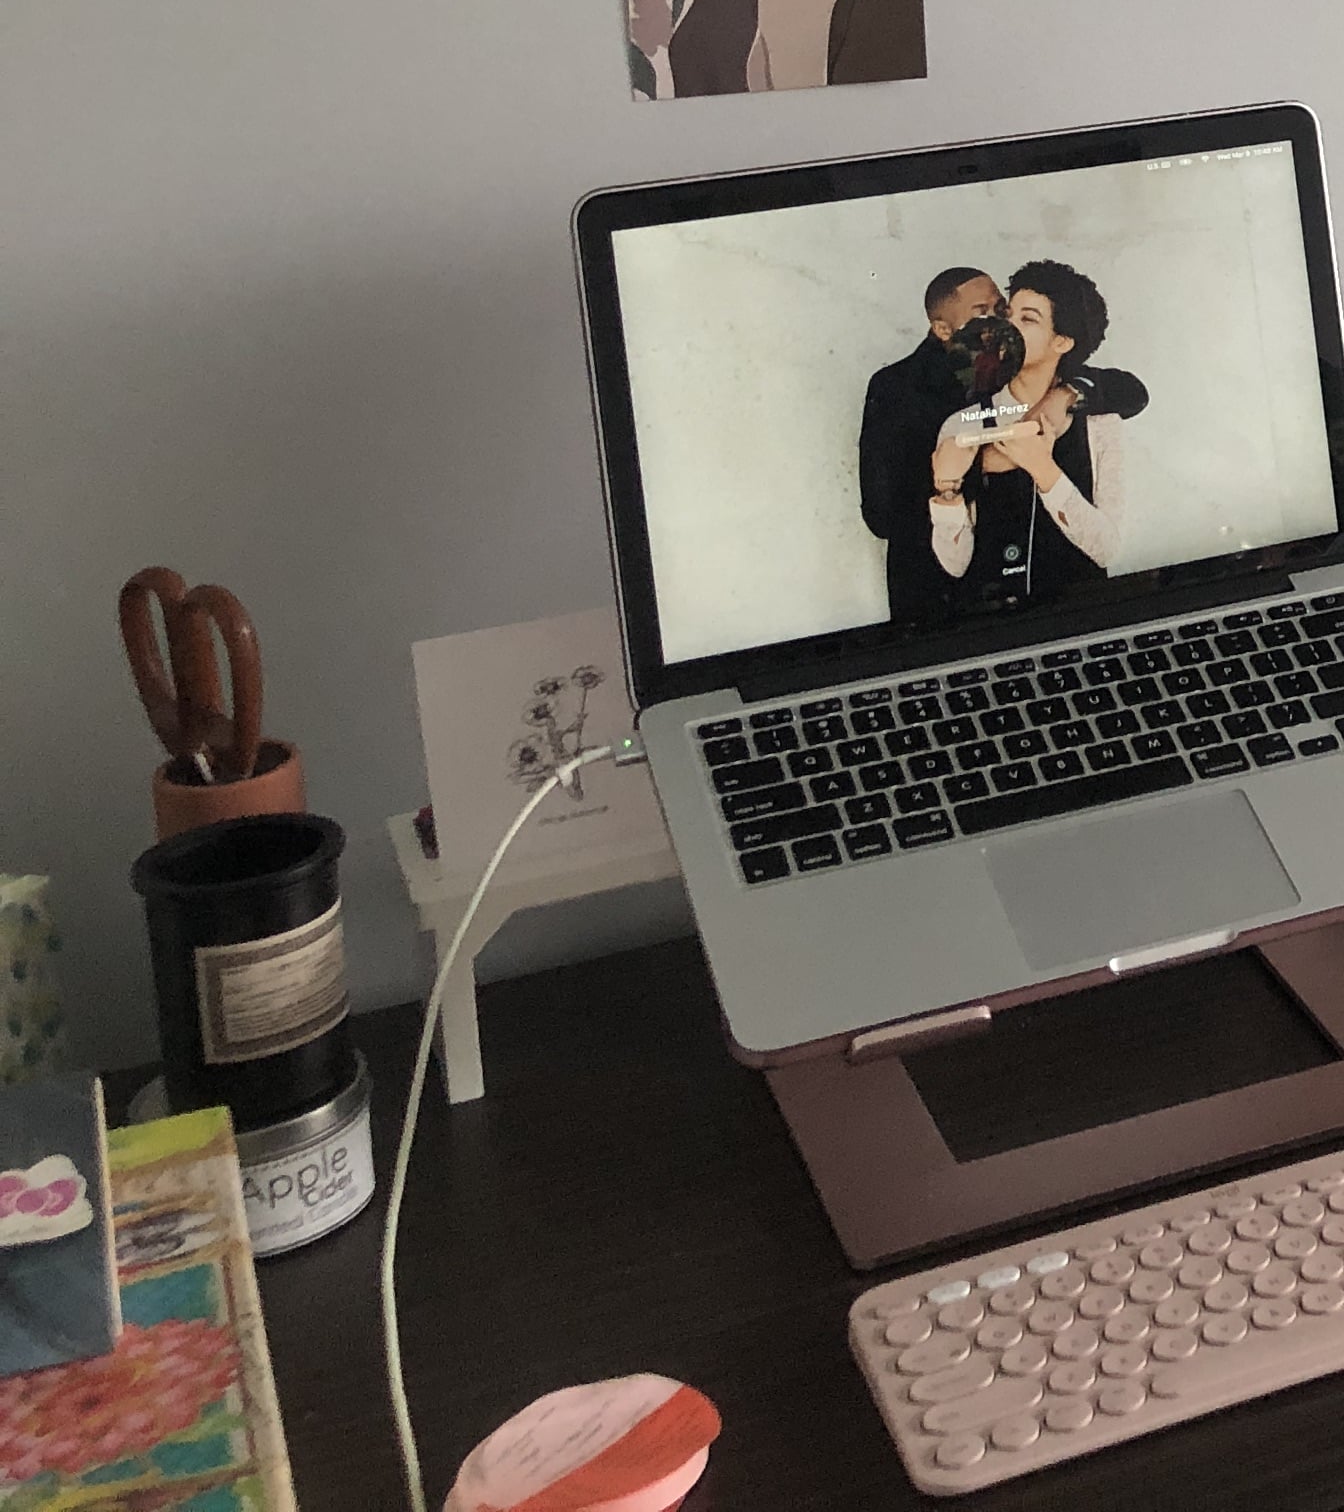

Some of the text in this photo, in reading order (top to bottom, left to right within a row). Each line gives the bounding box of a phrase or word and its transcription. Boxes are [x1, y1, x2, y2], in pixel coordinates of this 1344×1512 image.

[961, 403, 1030, 423] Natalia Perez
[242, 1146, 348, 1210] Apple
[303, 1170, 353, 1207] Cider
